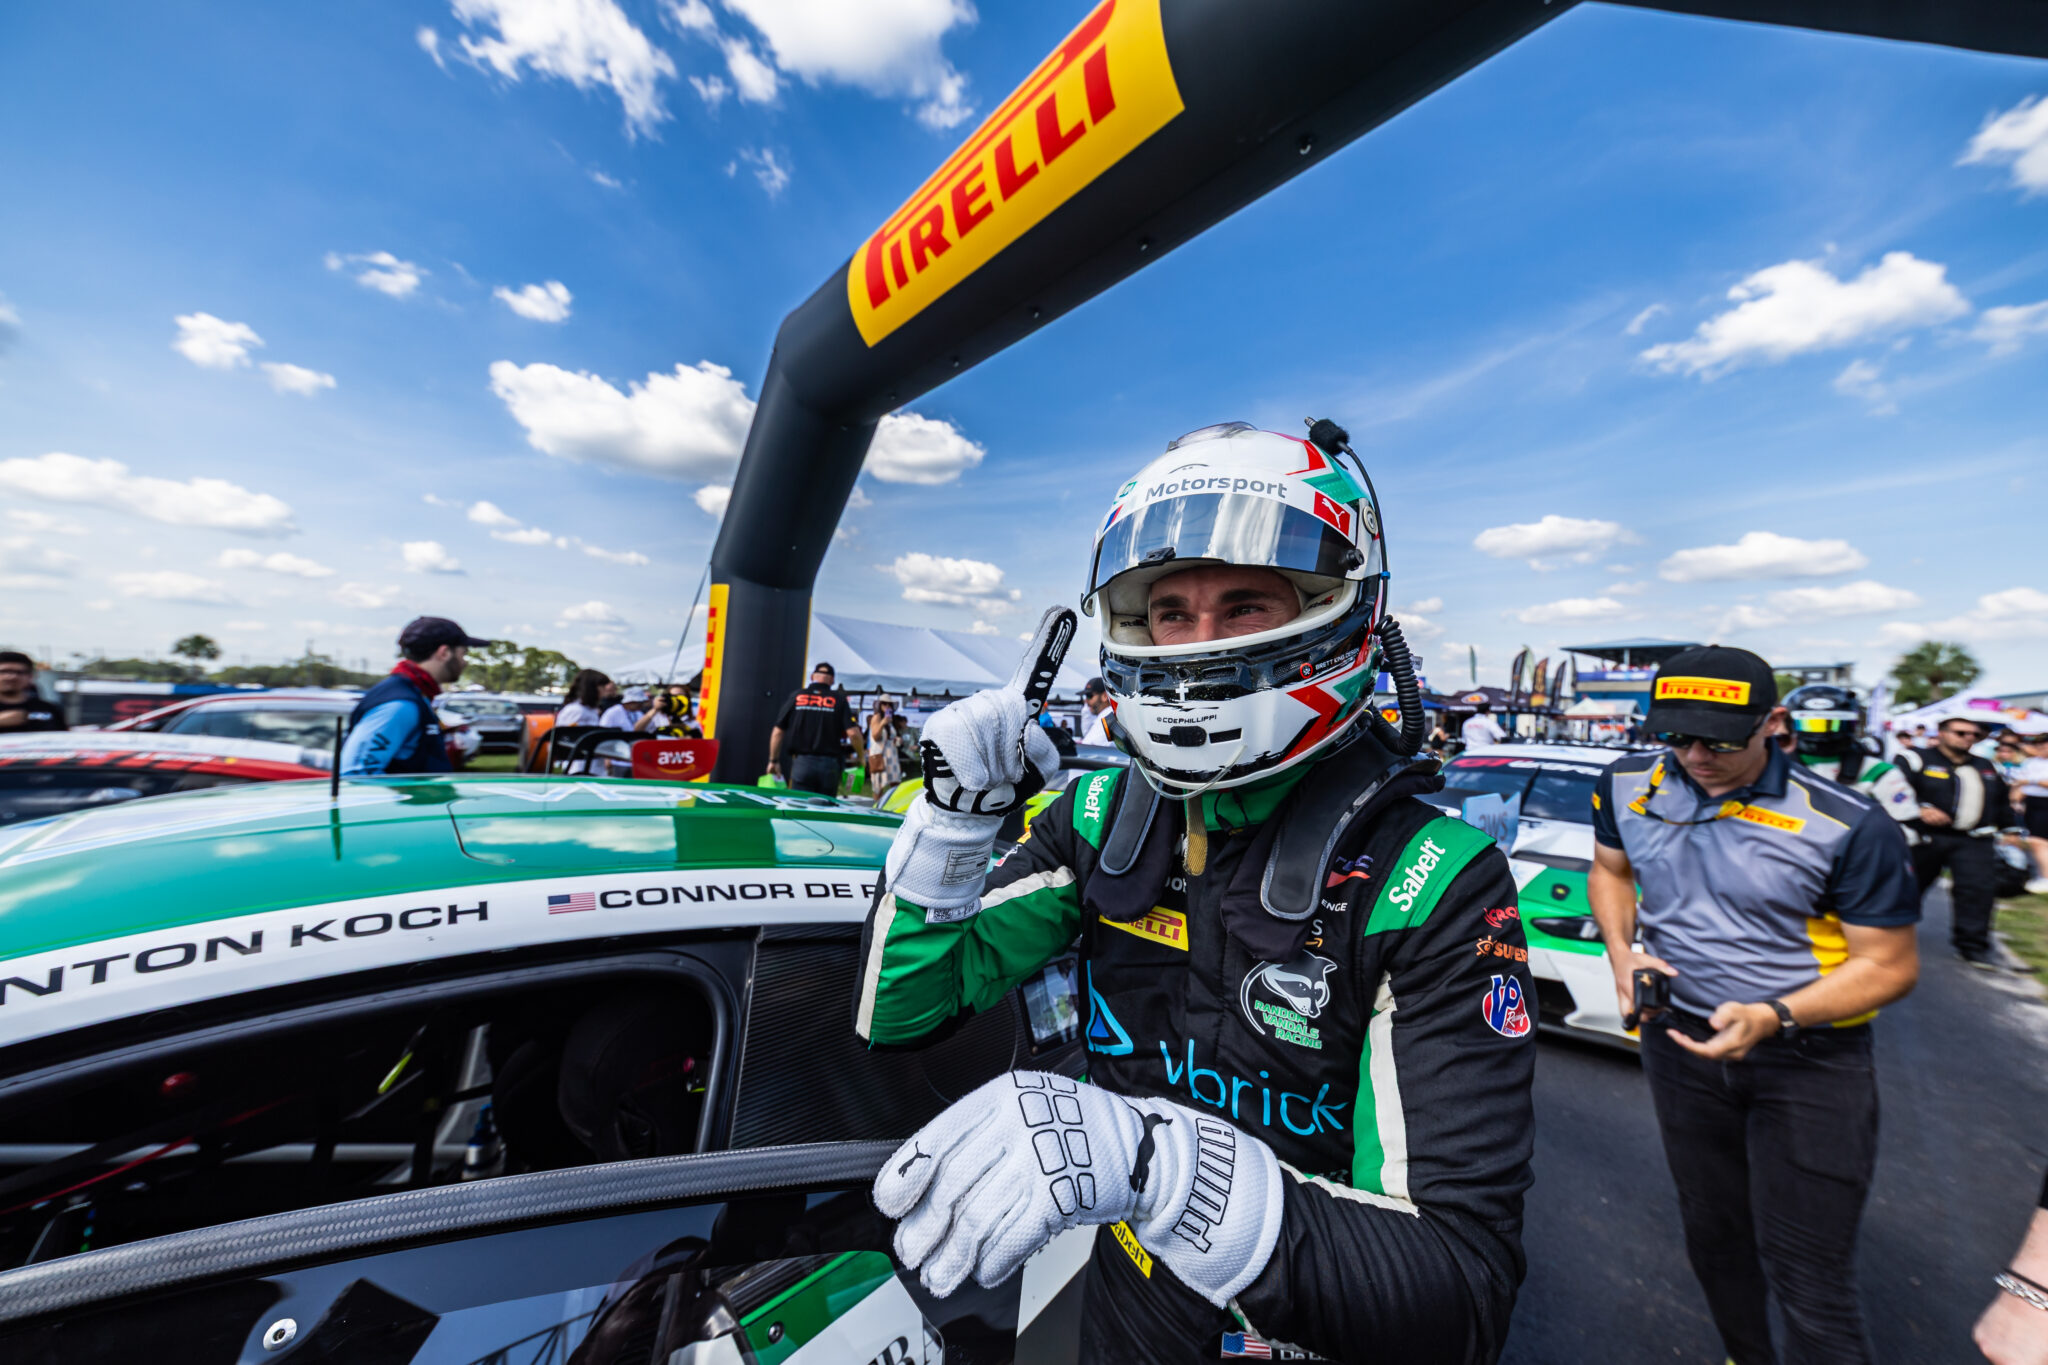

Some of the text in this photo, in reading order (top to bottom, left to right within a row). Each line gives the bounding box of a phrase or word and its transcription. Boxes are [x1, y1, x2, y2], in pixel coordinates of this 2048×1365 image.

[865, 0, 1116, 310] PIRELLI
[1145, 477, 1288, 502] Motorsport
[795, 694, 836, 708] SRO
[1661, 682, 1742, 700] PIRELLI
[657, 750, 695, 765] aws
[1084, 775, 1109, 822] Sabelt
[1388, 837, 1446, 912] Sabelt
[600, 883, 795, 909] CONNOR
[804, 883, 853, 899] DE
[0, 901, 489, 1006] NTON KOCH
[1493, 942, 1528, 963] SUER
[1254, 1000, 1307, 1025] RANDOM
[1263, 1012, 1320, 1039] VANDALS
[1275, 1027, 1322, 1049] RACING
[1159, 1038, 1349, 1136] vbrick
[1171, 1118, 1236, 1254] PUMA
[1114, 1224, 1145, 1269] abelt
